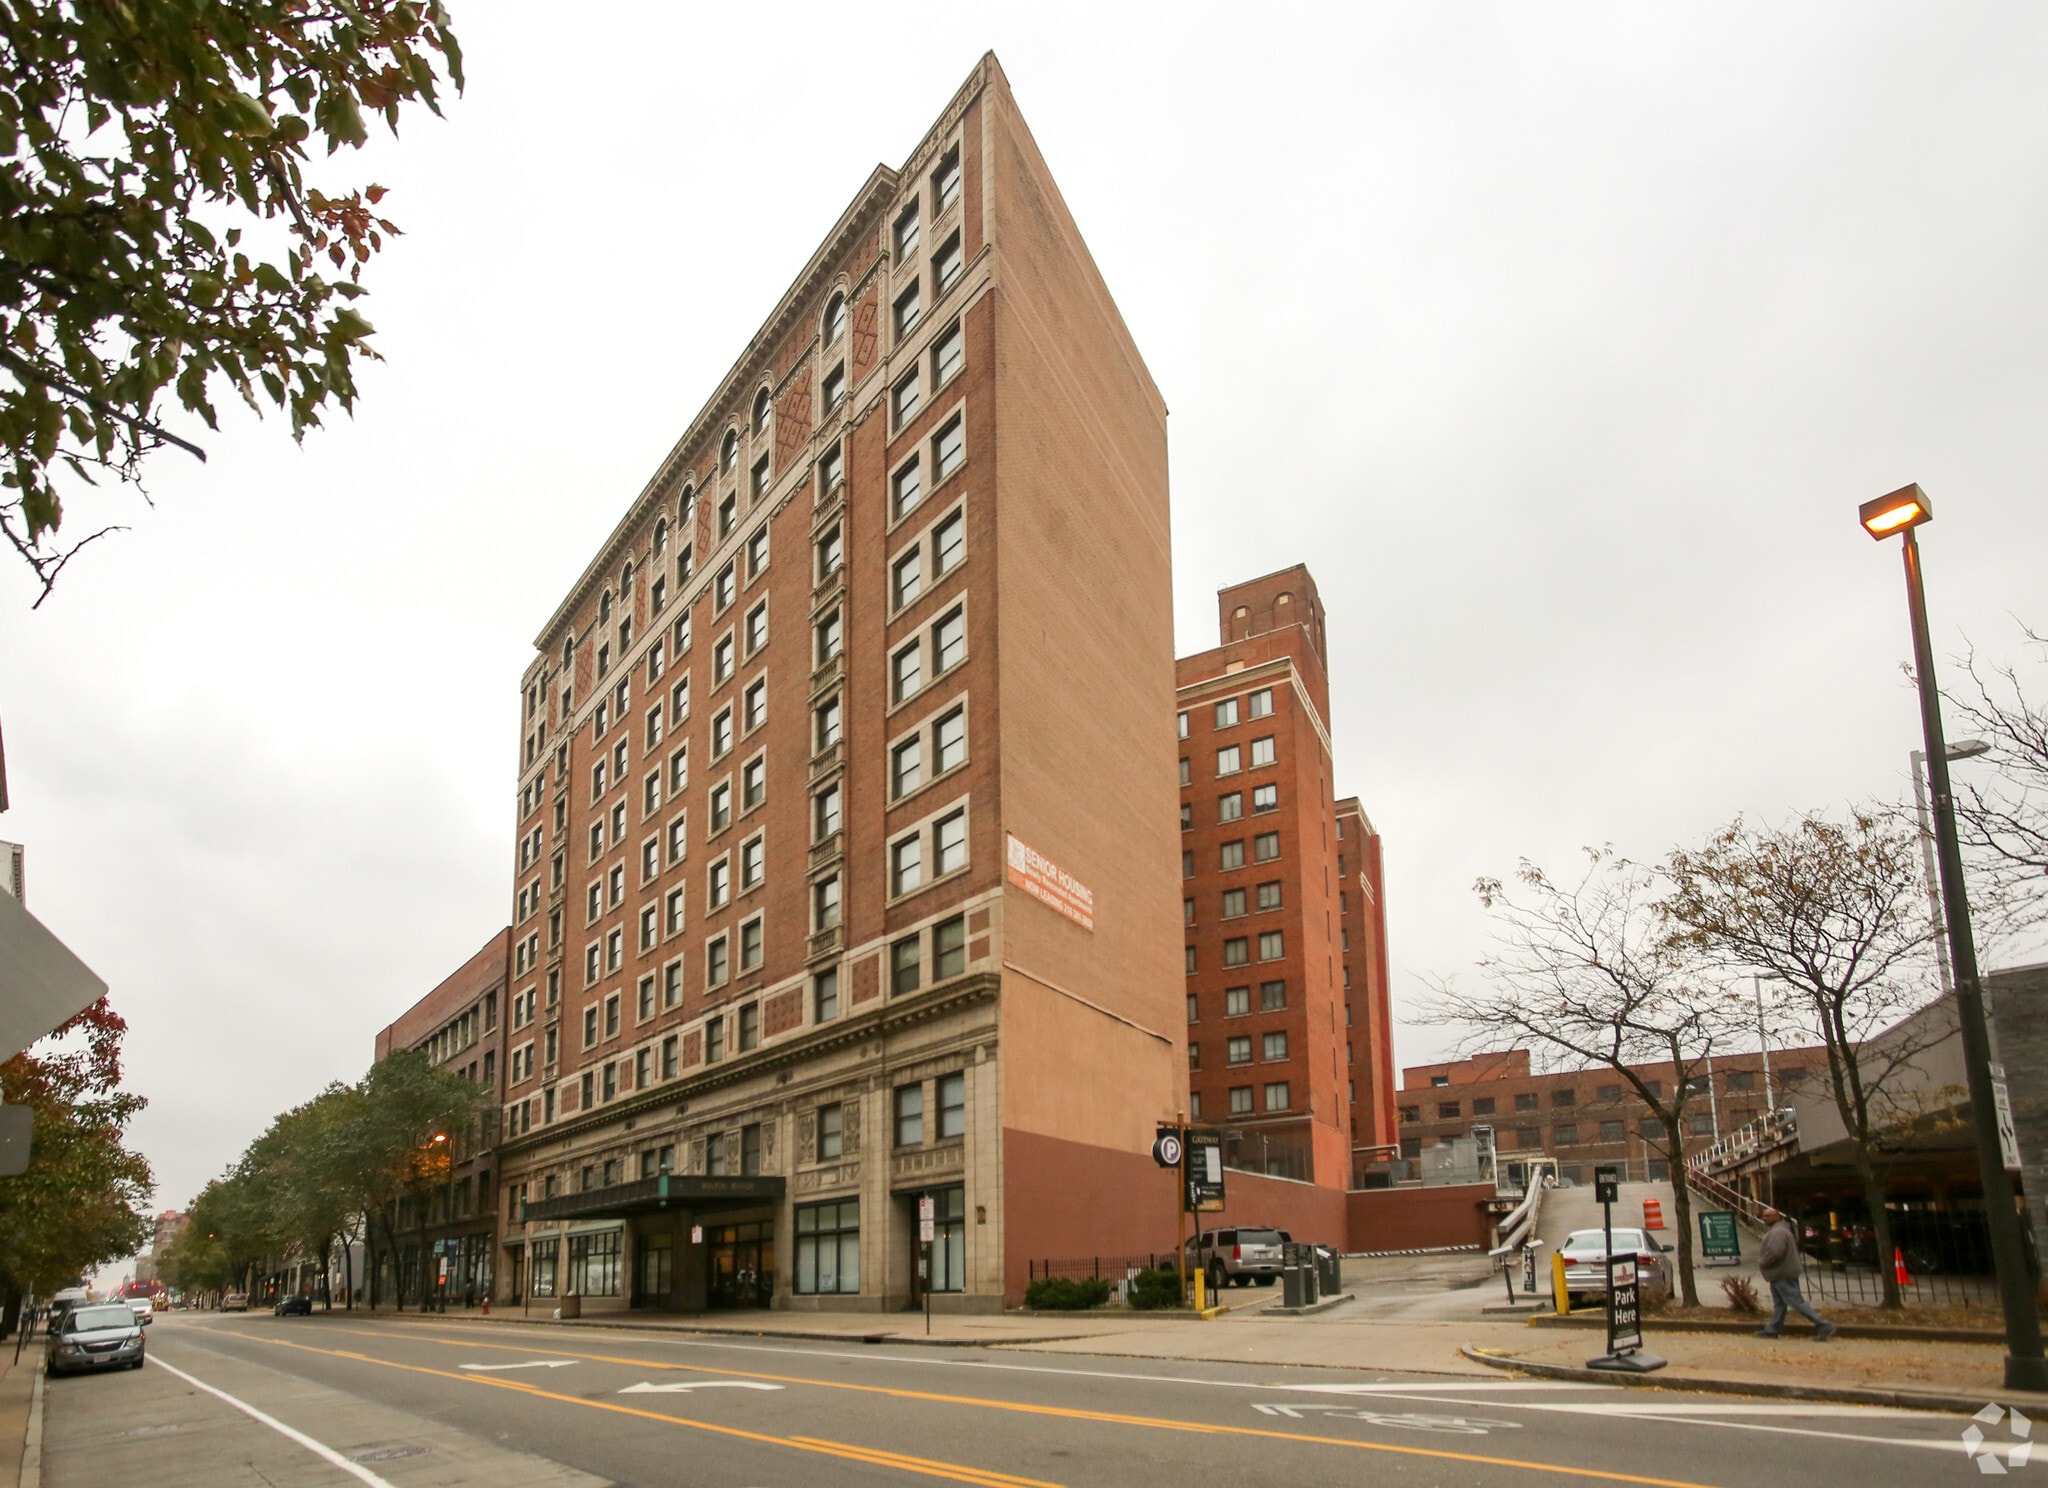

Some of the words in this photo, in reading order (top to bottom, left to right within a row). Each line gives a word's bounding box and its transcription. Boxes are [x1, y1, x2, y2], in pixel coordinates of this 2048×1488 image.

[1025, 846, 1057, 881] SENIOR
[1058, 870, 1092, 905] HOUSING
[1040, 887, 1062, 910] LEASING
[1192, 1135, 1219, 1144] GATEWAY
[1167, 1142, 1177, 1159] P
[1615, 1288, 1635, 1306] Park
[1615, 1309, 1636, 1325] Here
